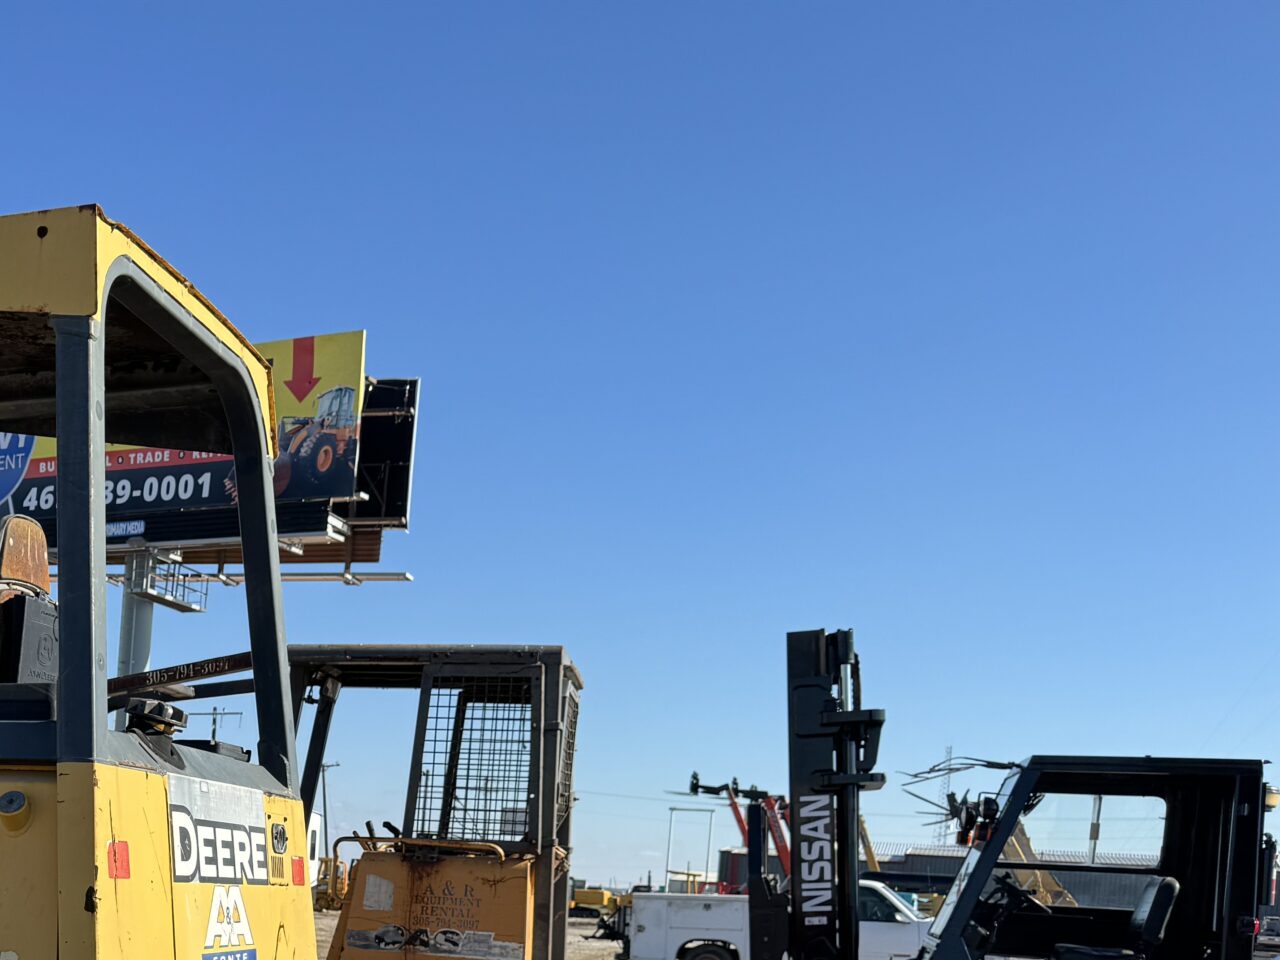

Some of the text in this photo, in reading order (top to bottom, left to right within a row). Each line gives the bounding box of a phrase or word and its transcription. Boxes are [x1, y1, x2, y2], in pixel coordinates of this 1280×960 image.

[39, 451, 170, 473] BU TRADE
[170, 808, 268, 880] DEERE
[800, 795, 832, 912] NISSAN
[414, 895, 481, 908] EQUIPMENT
[420, 905, 473, 919] RENTAL
